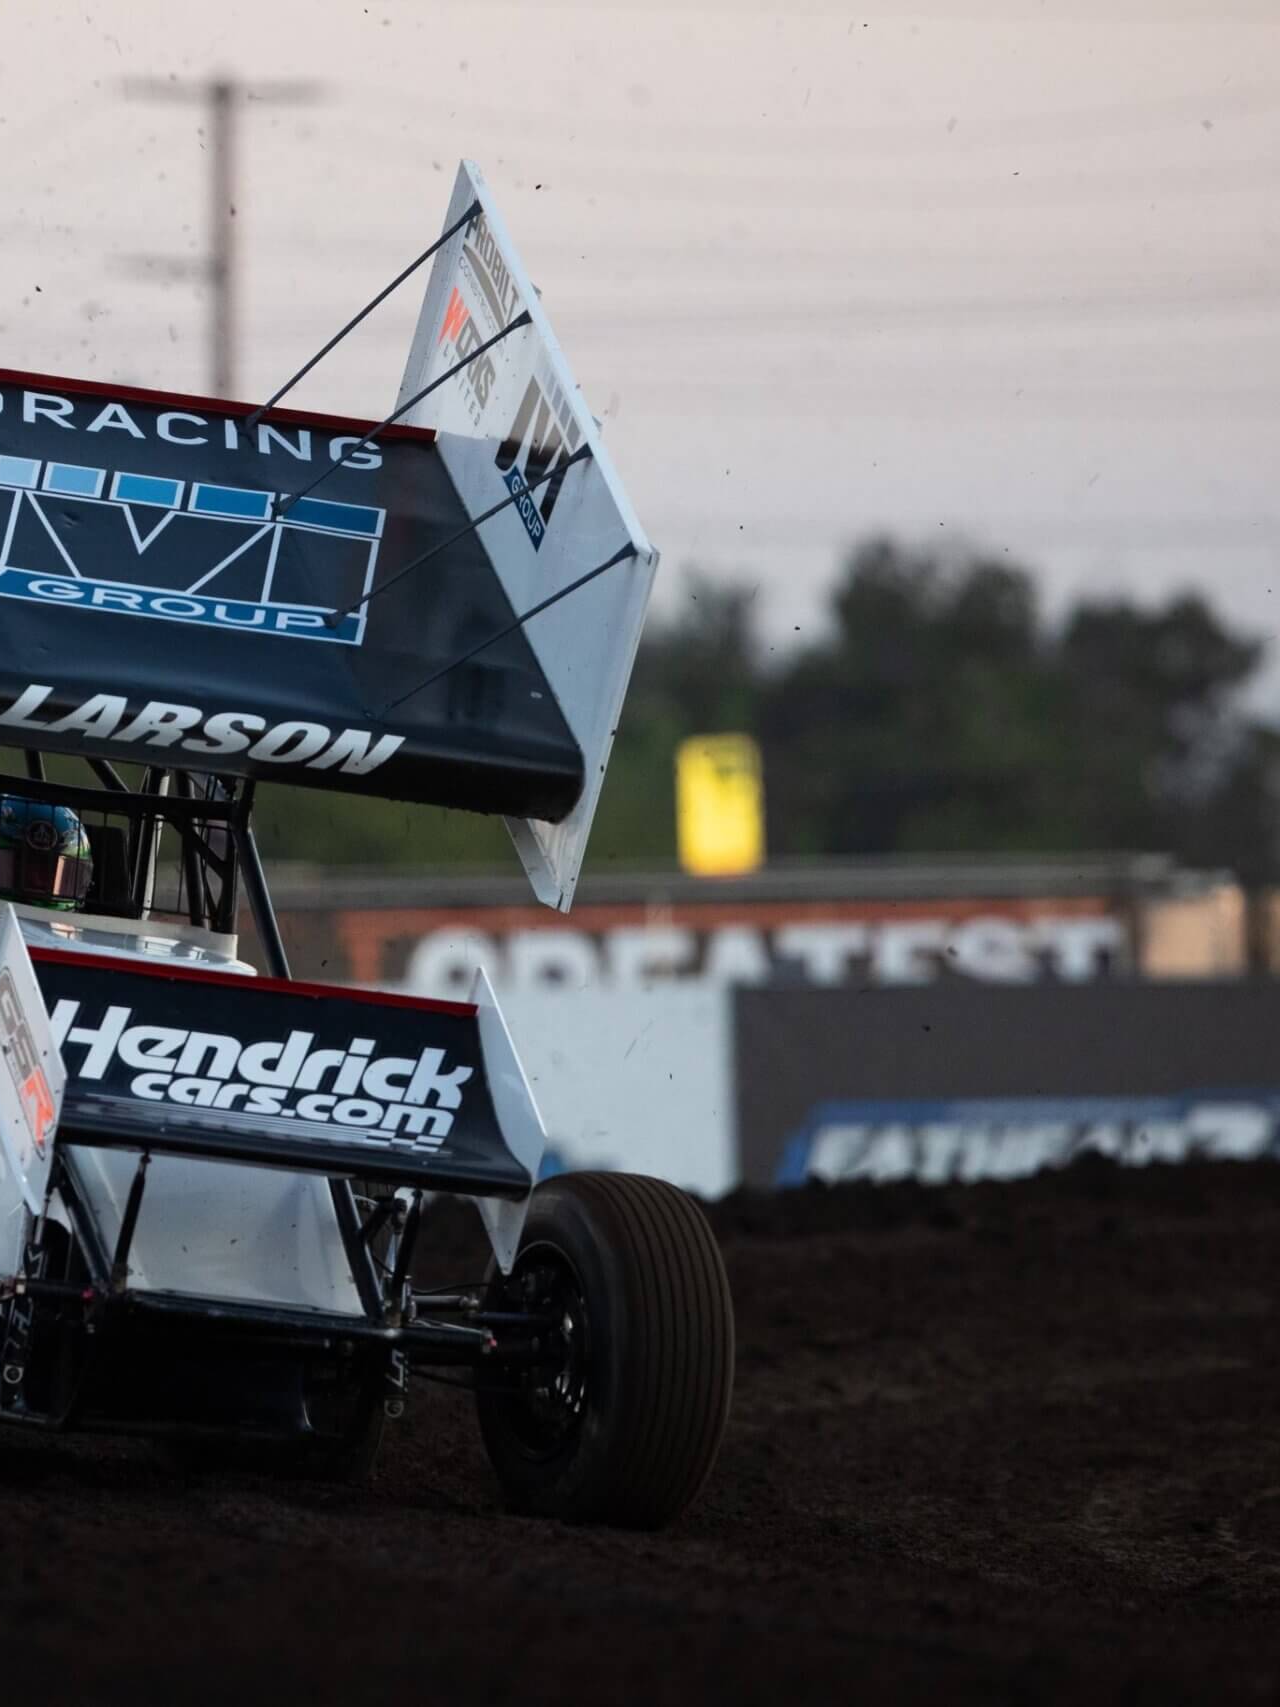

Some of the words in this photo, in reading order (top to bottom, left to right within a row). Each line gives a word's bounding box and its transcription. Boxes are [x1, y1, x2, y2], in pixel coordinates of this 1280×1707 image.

[27, 578, 326, 630] GROUP
[52, 999, 473, 1109] Hendrick
[131, 1070, 454, 1138] cars.com
